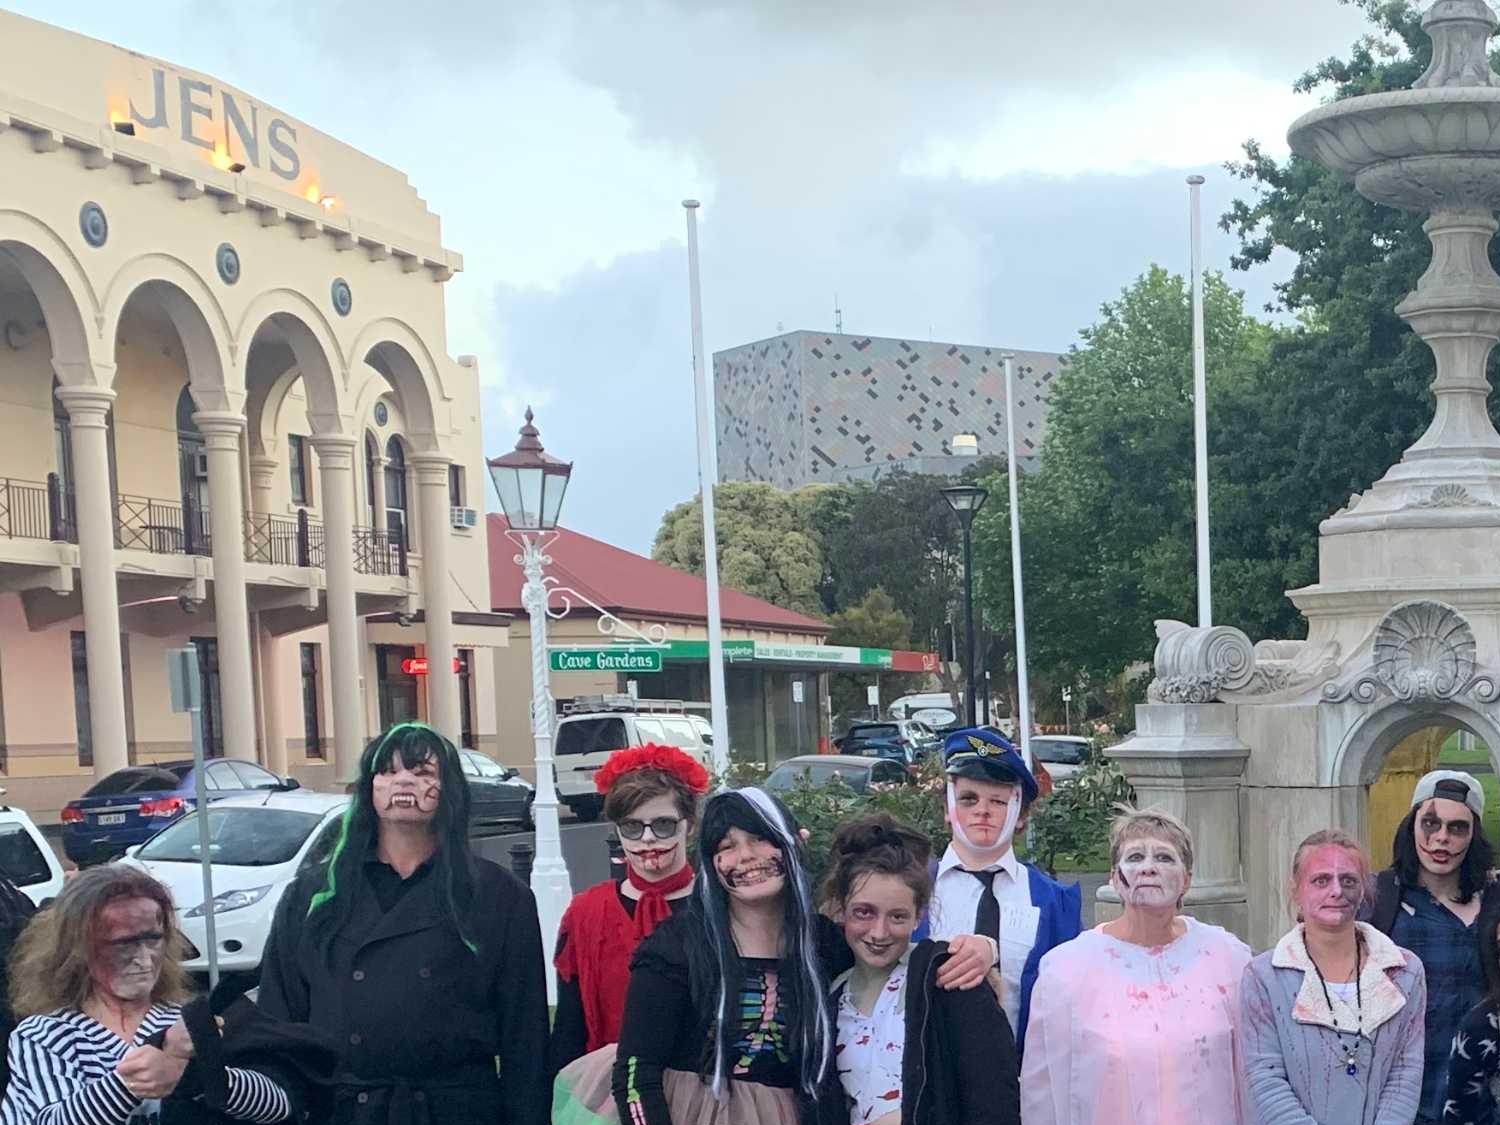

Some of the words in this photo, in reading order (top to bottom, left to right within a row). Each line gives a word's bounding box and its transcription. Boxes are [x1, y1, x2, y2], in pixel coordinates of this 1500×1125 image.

[129, 68, 300, 181] JENS
[558, 652, 591, 669] Cave
[596, 651, 653, 669] Gardens
